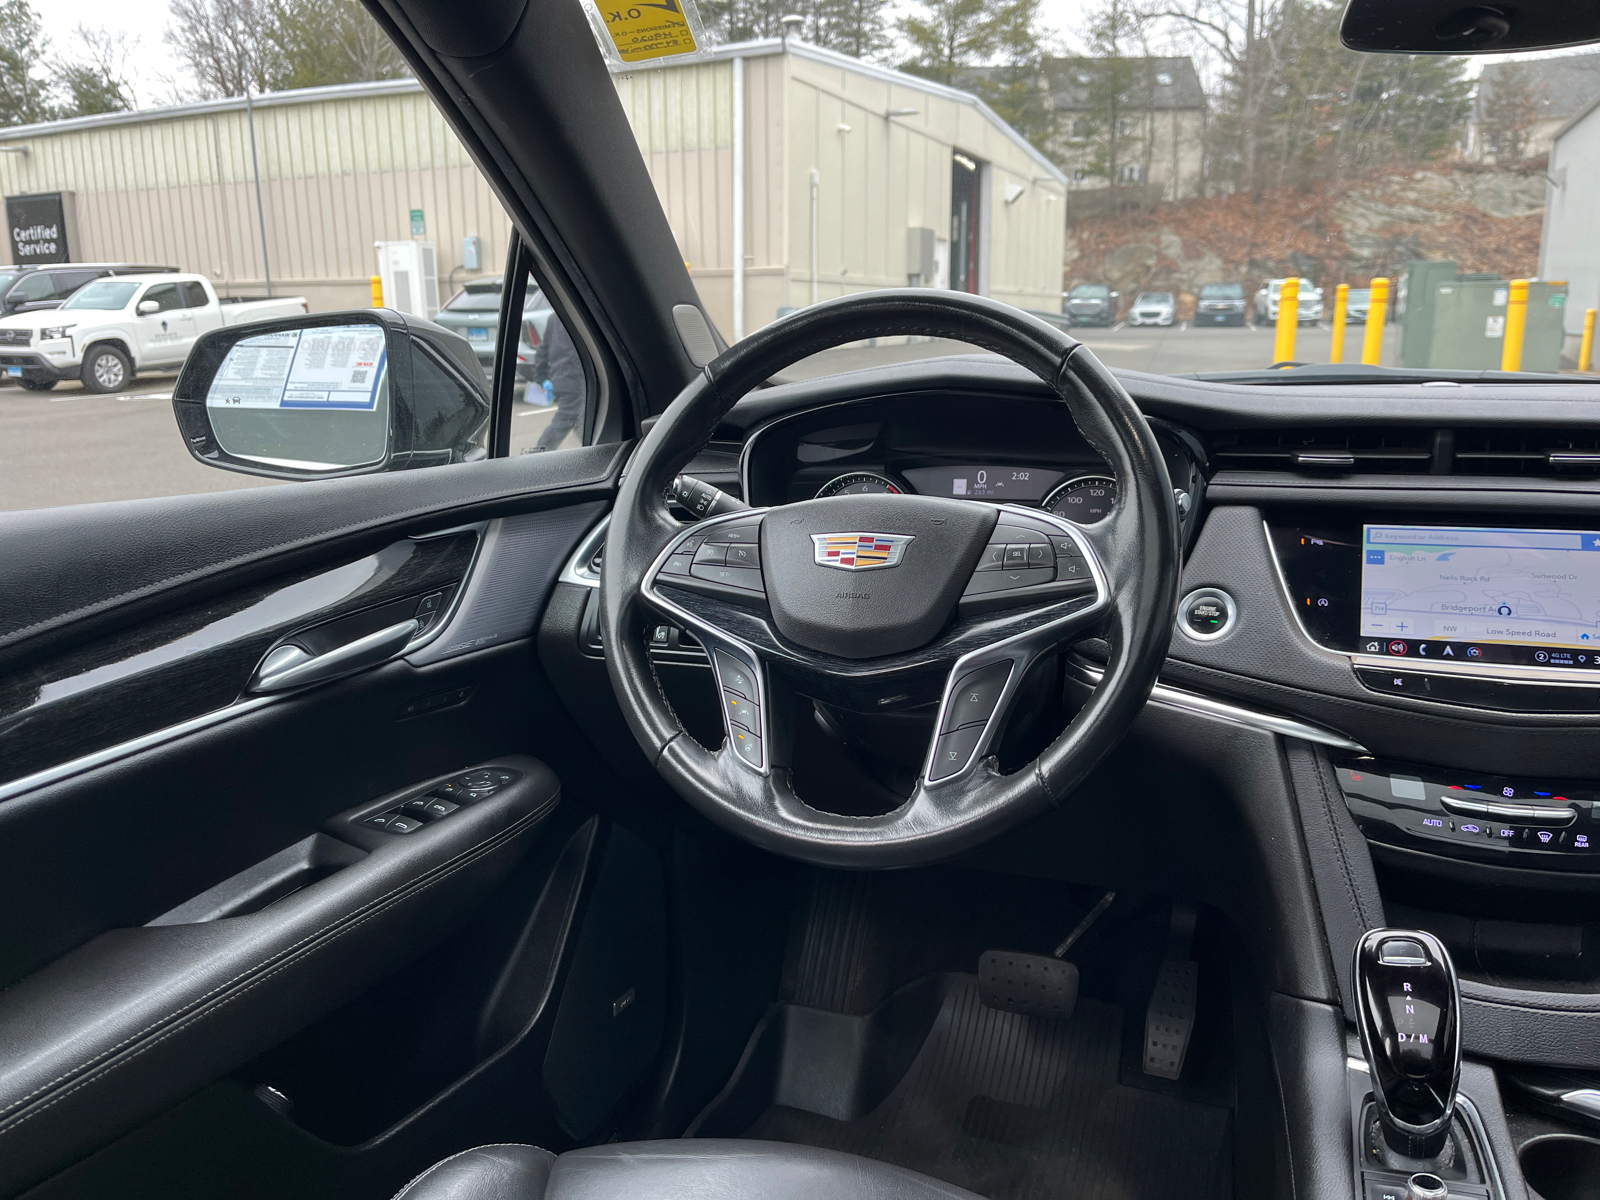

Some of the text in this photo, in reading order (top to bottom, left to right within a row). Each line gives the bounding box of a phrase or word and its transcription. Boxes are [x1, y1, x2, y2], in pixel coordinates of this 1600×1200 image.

[13, 224, 59, 243] Certified
[17, 240, 58, 257] Service
[977, 470, 987, 484] 0
[1011, 472, 1030, 480] 2:02
[1067, 496, 1083, 504] 100
[1384, 533, 1416, 542] Keyword
[1428, 534, 1459, 542] Address
[1389, 554, 1416, 563] English
[1439, 574, 1490, 583] Nells Rock Rd
[1531, 573, 1566, 581] Sunwood
[835, 592, 870, 600] AIRBAG
[1441, 604, 1486, 613] Bridgeport
[1486, 628, 1557, 639] Low Speed Road
[1422, 818, 1443, 828] AUTO
[1500, 830, 1514, 838] OFF
[1403, 982, 1412, 992] R
[1405, 1005, 1415, 1014] N
